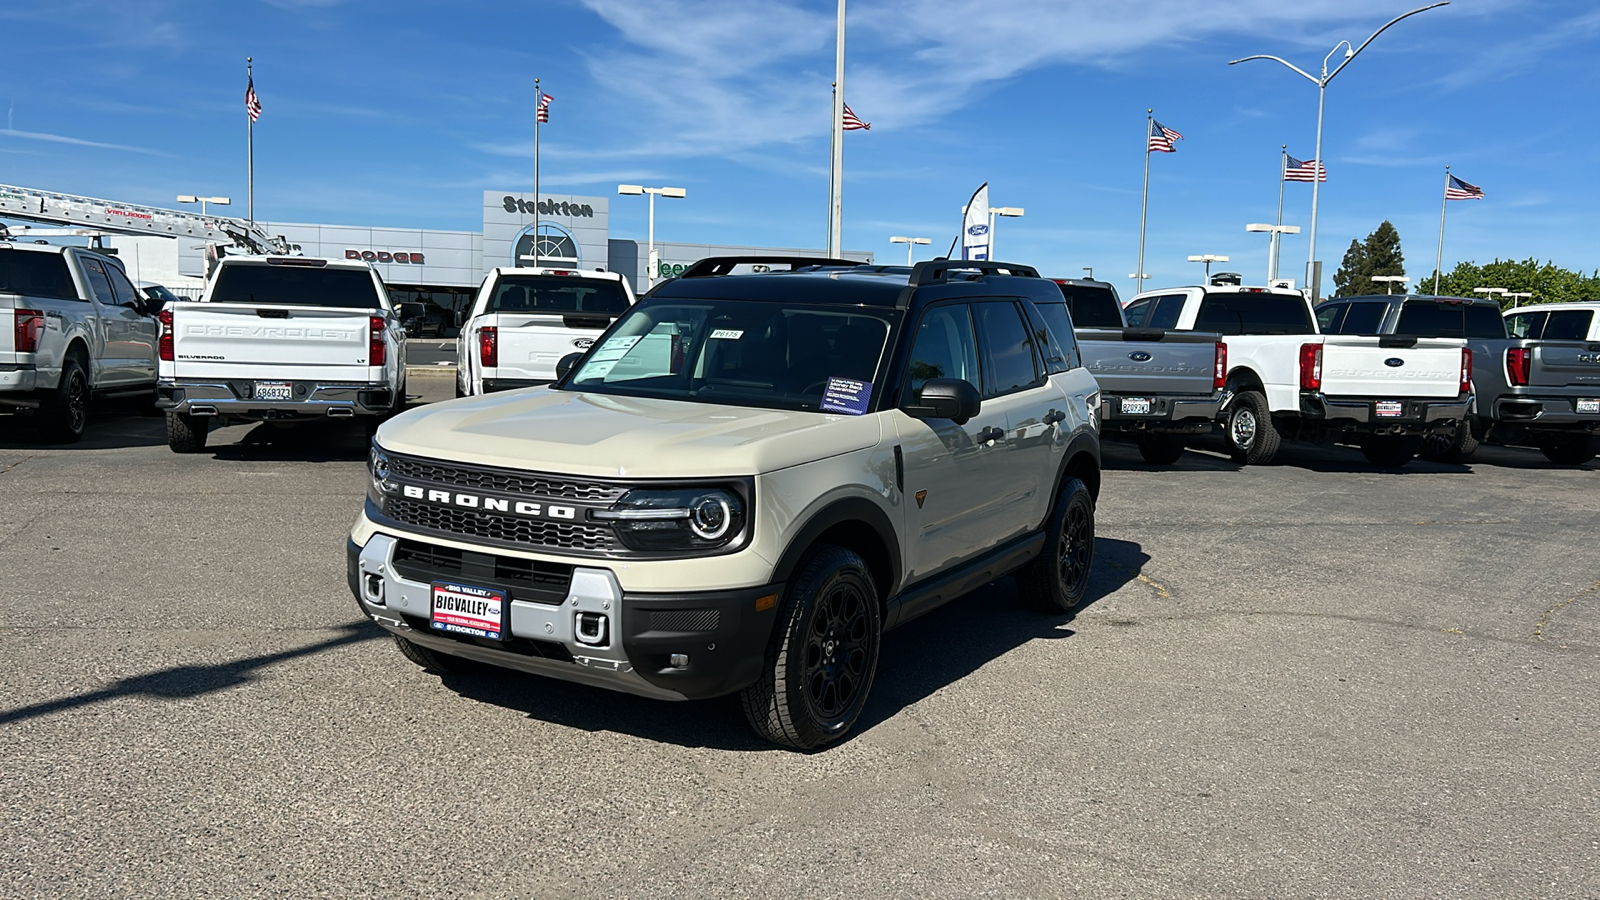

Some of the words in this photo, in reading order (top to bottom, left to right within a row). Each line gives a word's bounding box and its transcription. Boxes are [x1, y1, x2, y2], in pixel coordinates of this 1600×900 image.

[502, 195, 594, 218] Stockton
[123, 211, 153, 220] LADDER
[970, 225, 988, 235] Ford
[345, 249, 425, 265] DODGE
[186, 324, 358, 341] CHEVROLET
[714, 330, 739, 338] P6175
[576, 339, 595, 349] Ford
[177, 353, 226, 361] SILVERADO
[1151, 364, 1208, 374] DUTY
[1330, 369, 1400, 379] SUPER
[1402, 370, 1456, 380] DUTY
[404, 485, 575, 519] BRONCO
[461, 586, 487, 597] VALLEY
[436, 595, 489, 616] BIGVALLEY
[446, 624, 486, 637] STOCKTON
